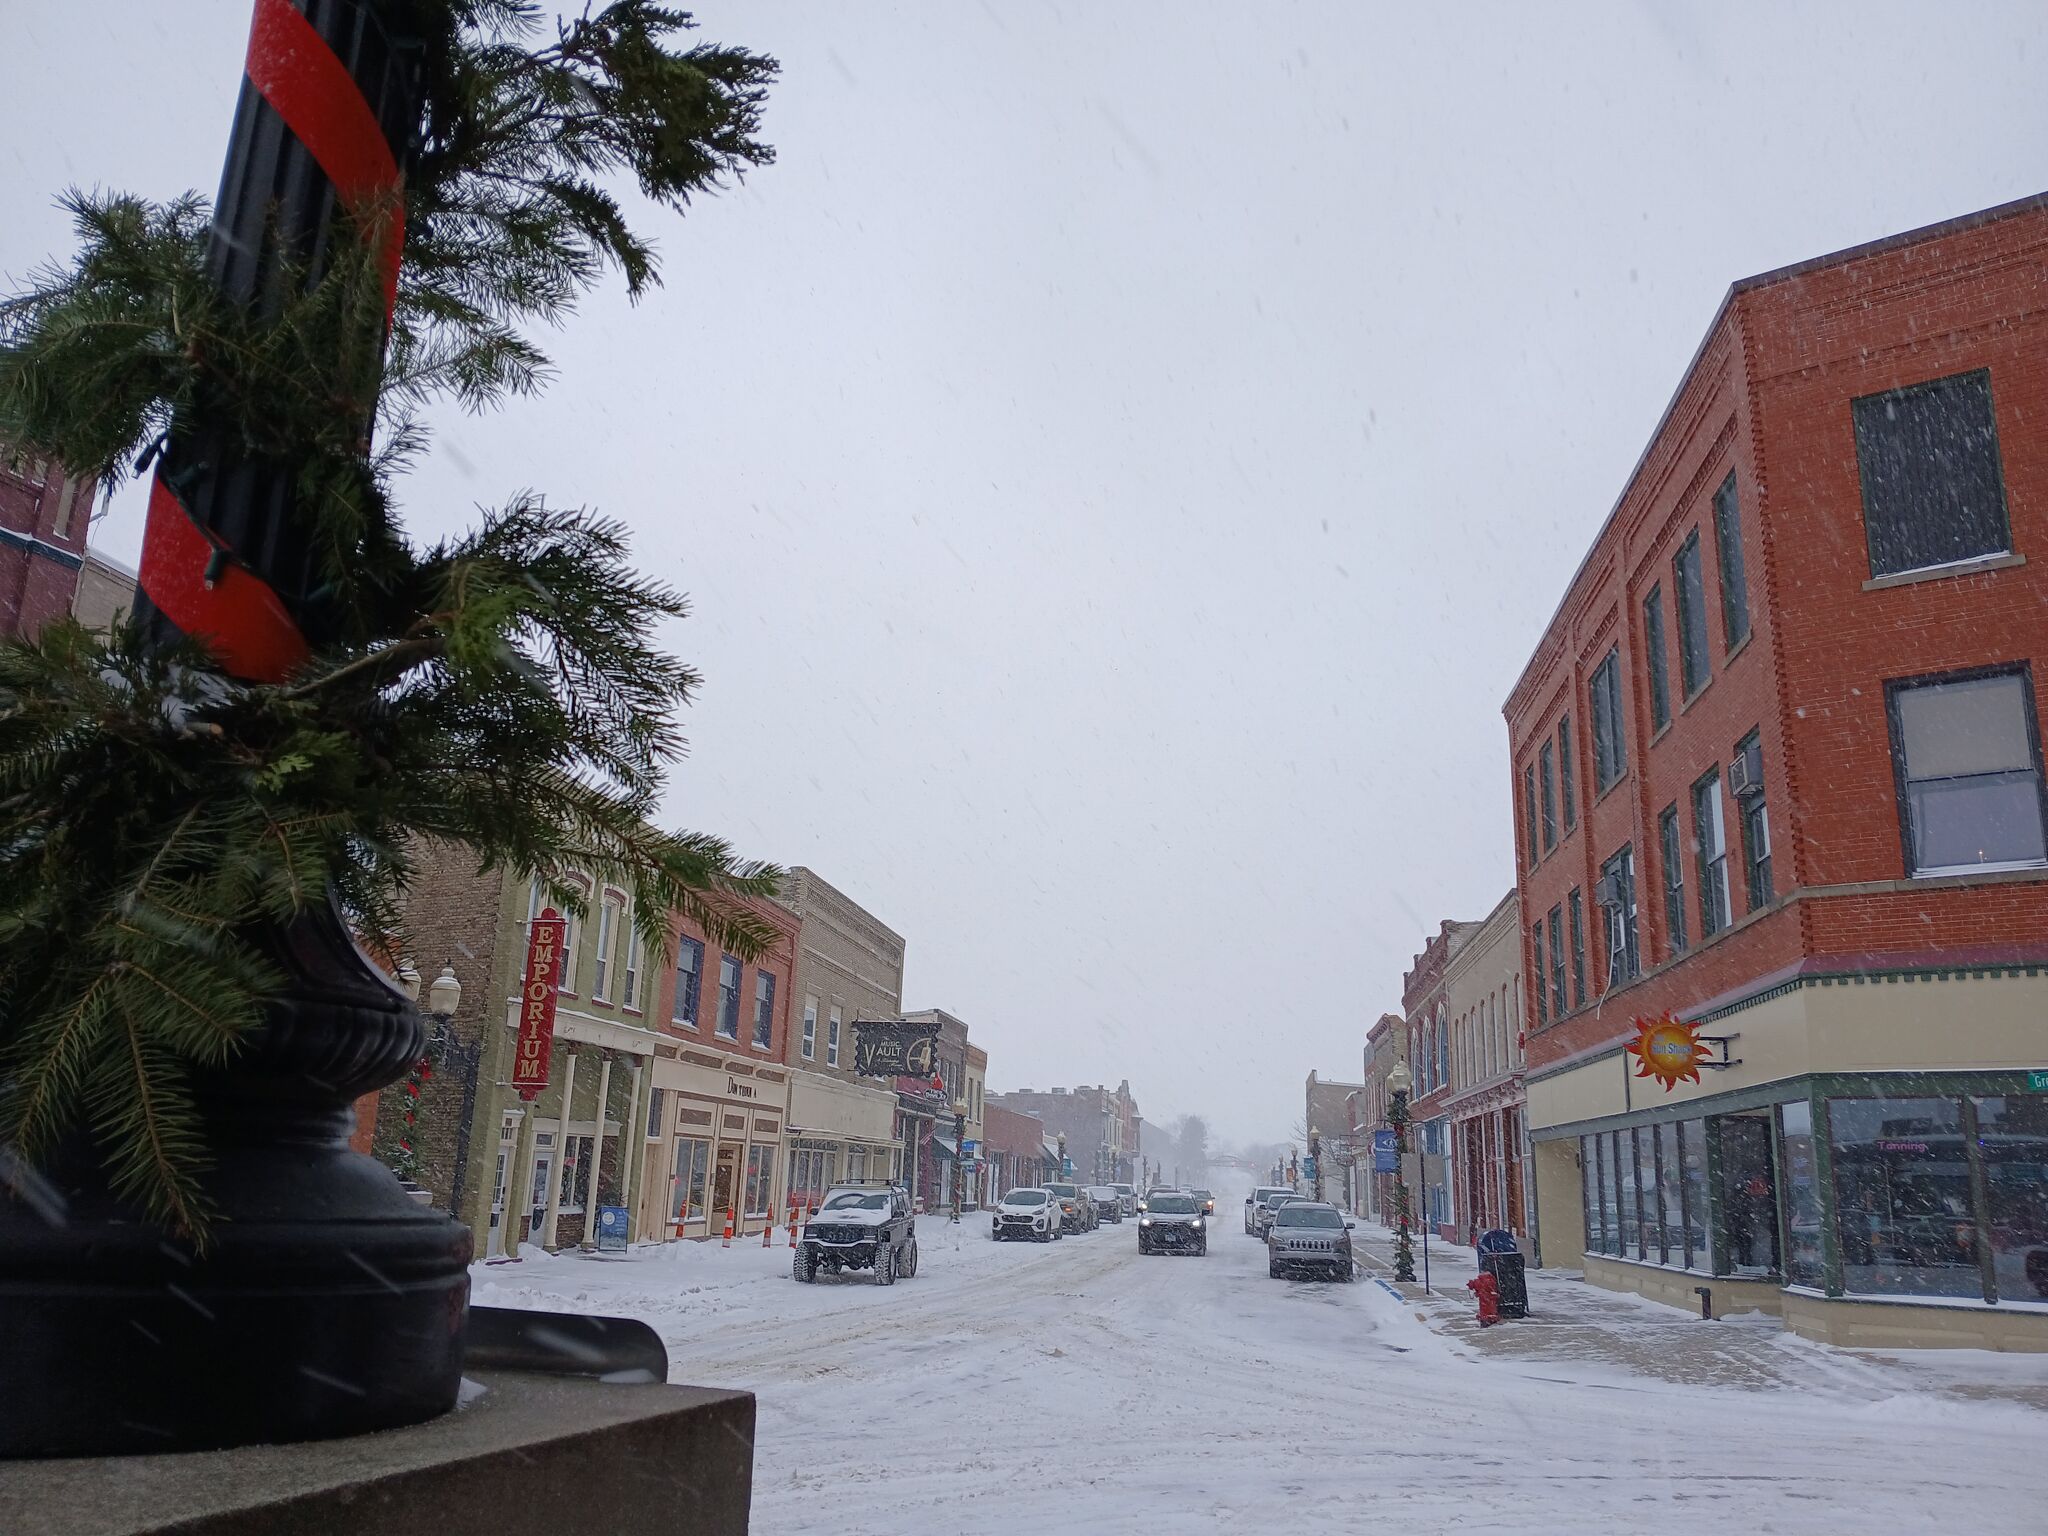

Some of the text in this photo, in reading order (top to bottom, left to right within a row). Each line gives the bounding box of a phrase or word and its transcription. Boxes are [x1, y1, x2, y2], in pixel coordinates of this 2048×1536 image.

[519, 926, 553, 1078] EMPORIUM
[864, 1044, 902, 1067] VAULT
[1877, 1141, 1925, 1152] Tanning
